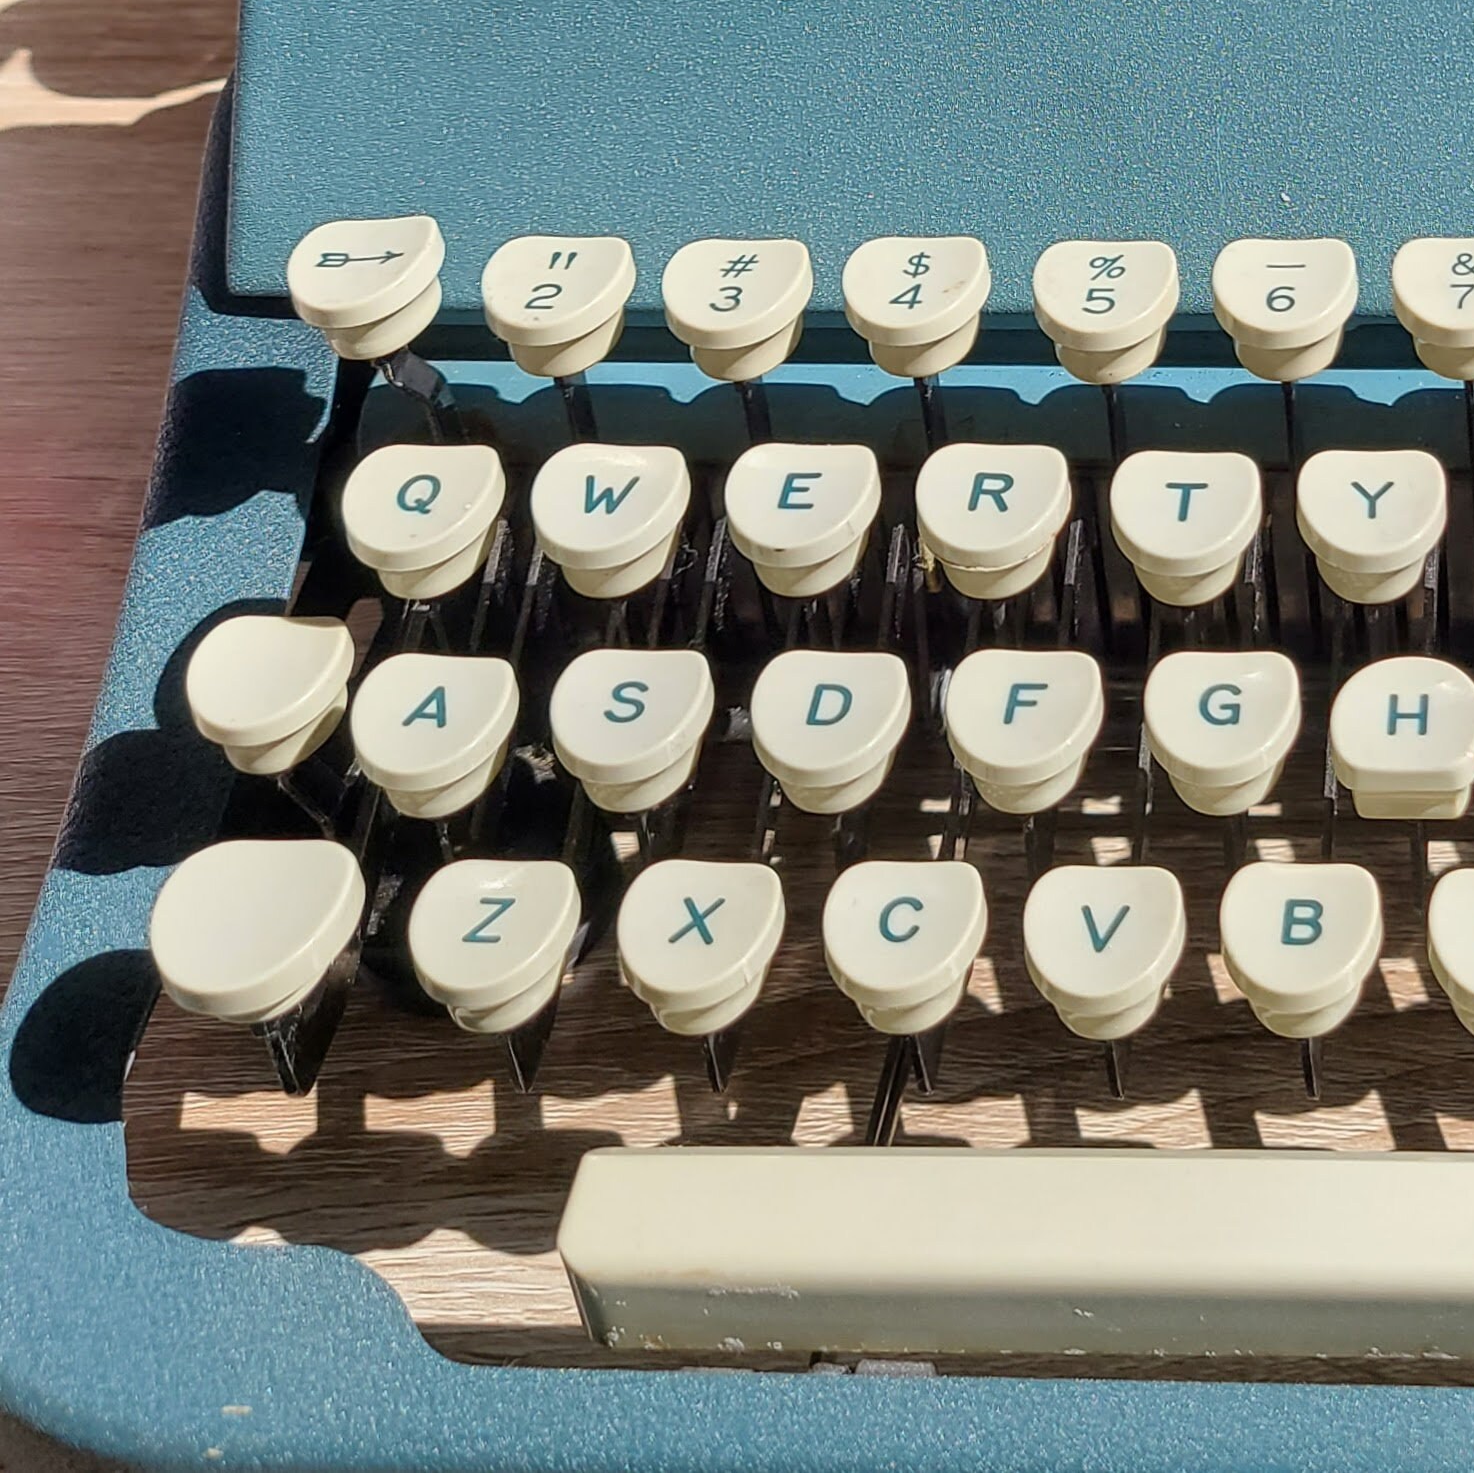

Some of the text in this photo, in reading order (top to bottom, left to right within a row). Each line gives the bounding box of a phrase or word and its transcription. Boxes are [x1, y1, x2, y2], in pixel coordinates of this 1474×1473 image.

[718, 252, 761, 280] #
[901, 250, 933, 280] $
[1087, 253, 1128, 282] %
[522, 282, 564, 311] 2
[707, 284, 745, 314] 3
[887, 282, 924, 311] 4
[1080, 286, 1117, 316] 5
[1264, 284, 1297, 314] 6
[395, 473, 443, 516] Q
[582, 473, 642, 516] W
[775, 471, 824, 511] E
[966, 470, 1016, 514] R
[1163, 481, 1210, 524] T
[1349, 480, 1396, 521] Y
[400, 684, 449, 730] A
[602, 680, 651, 725] S
[804, 682, 854, 728] D
[1001, 681, 1050, 726] F
[1197, 682, 1244, 728] G
[1385, 692, 1431, 737] H
[460, 896, 517, 945] Z
[666, 895, 727, 947] X
[877, 895, 926, 945] C
[1079, 903, 1132, 955] V
[1279, 897, 1325, 947] B
